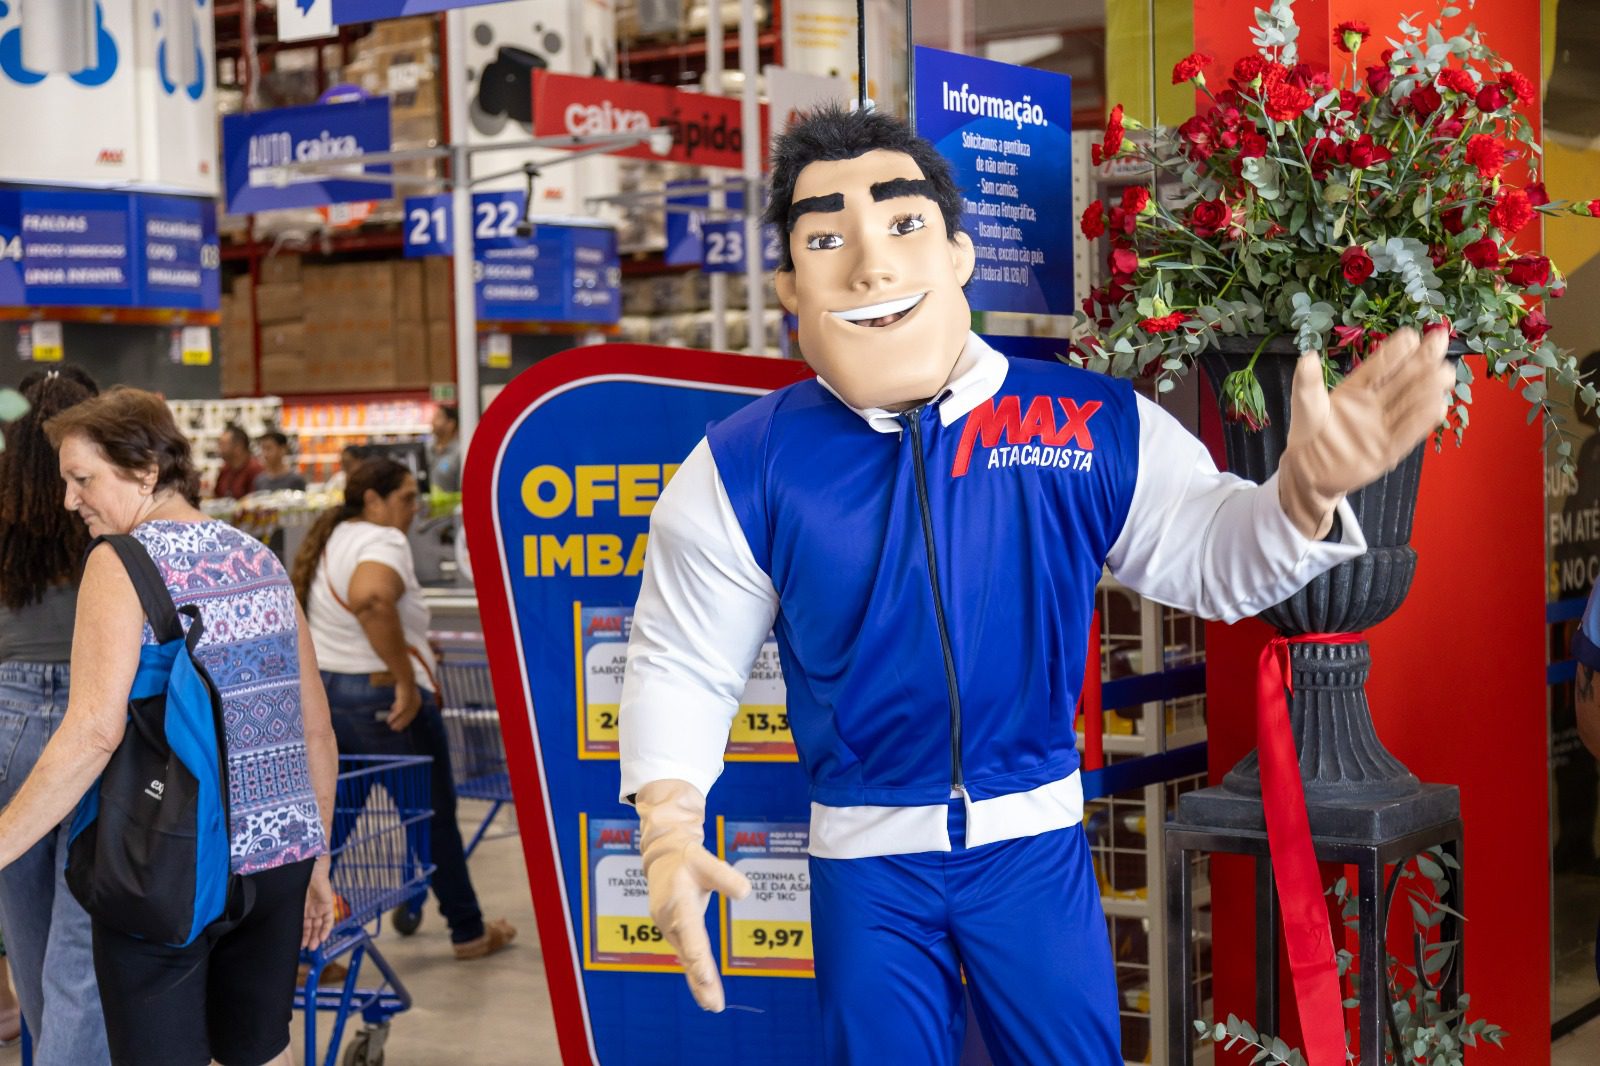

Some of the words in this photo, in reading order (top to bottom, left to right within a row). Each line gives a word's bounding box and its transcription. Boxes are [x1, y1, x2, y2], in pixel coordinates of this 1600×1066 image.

[564, 101, 650, 137] caixa
[942, 81, 1048, 130] Informação.
[962, 131, 997, 152] Solicitamos
[998, 140, 1003, 153] a
[1003, 140, 1031, 157] gentileza
[976, 155, 984, 172] de
[985, 156, 996, 174] não
[981, 177, 995, 195] Sem
[409, 208, 447, 245] 21
[475, 201, 518, 239] 22
[979, 221, 1001, 239] Usando
[705, 231, 743, 265] 23
[951, 395, 1103, 478] MAX
[987, 445, 1093, 473] ATACADISTA
[521, 463, 680, 519] OFE
[1562, 557, 1586, 591] NO
[770, 883, 787, 891] DA
[753, 929, 804, 949] 9,97
